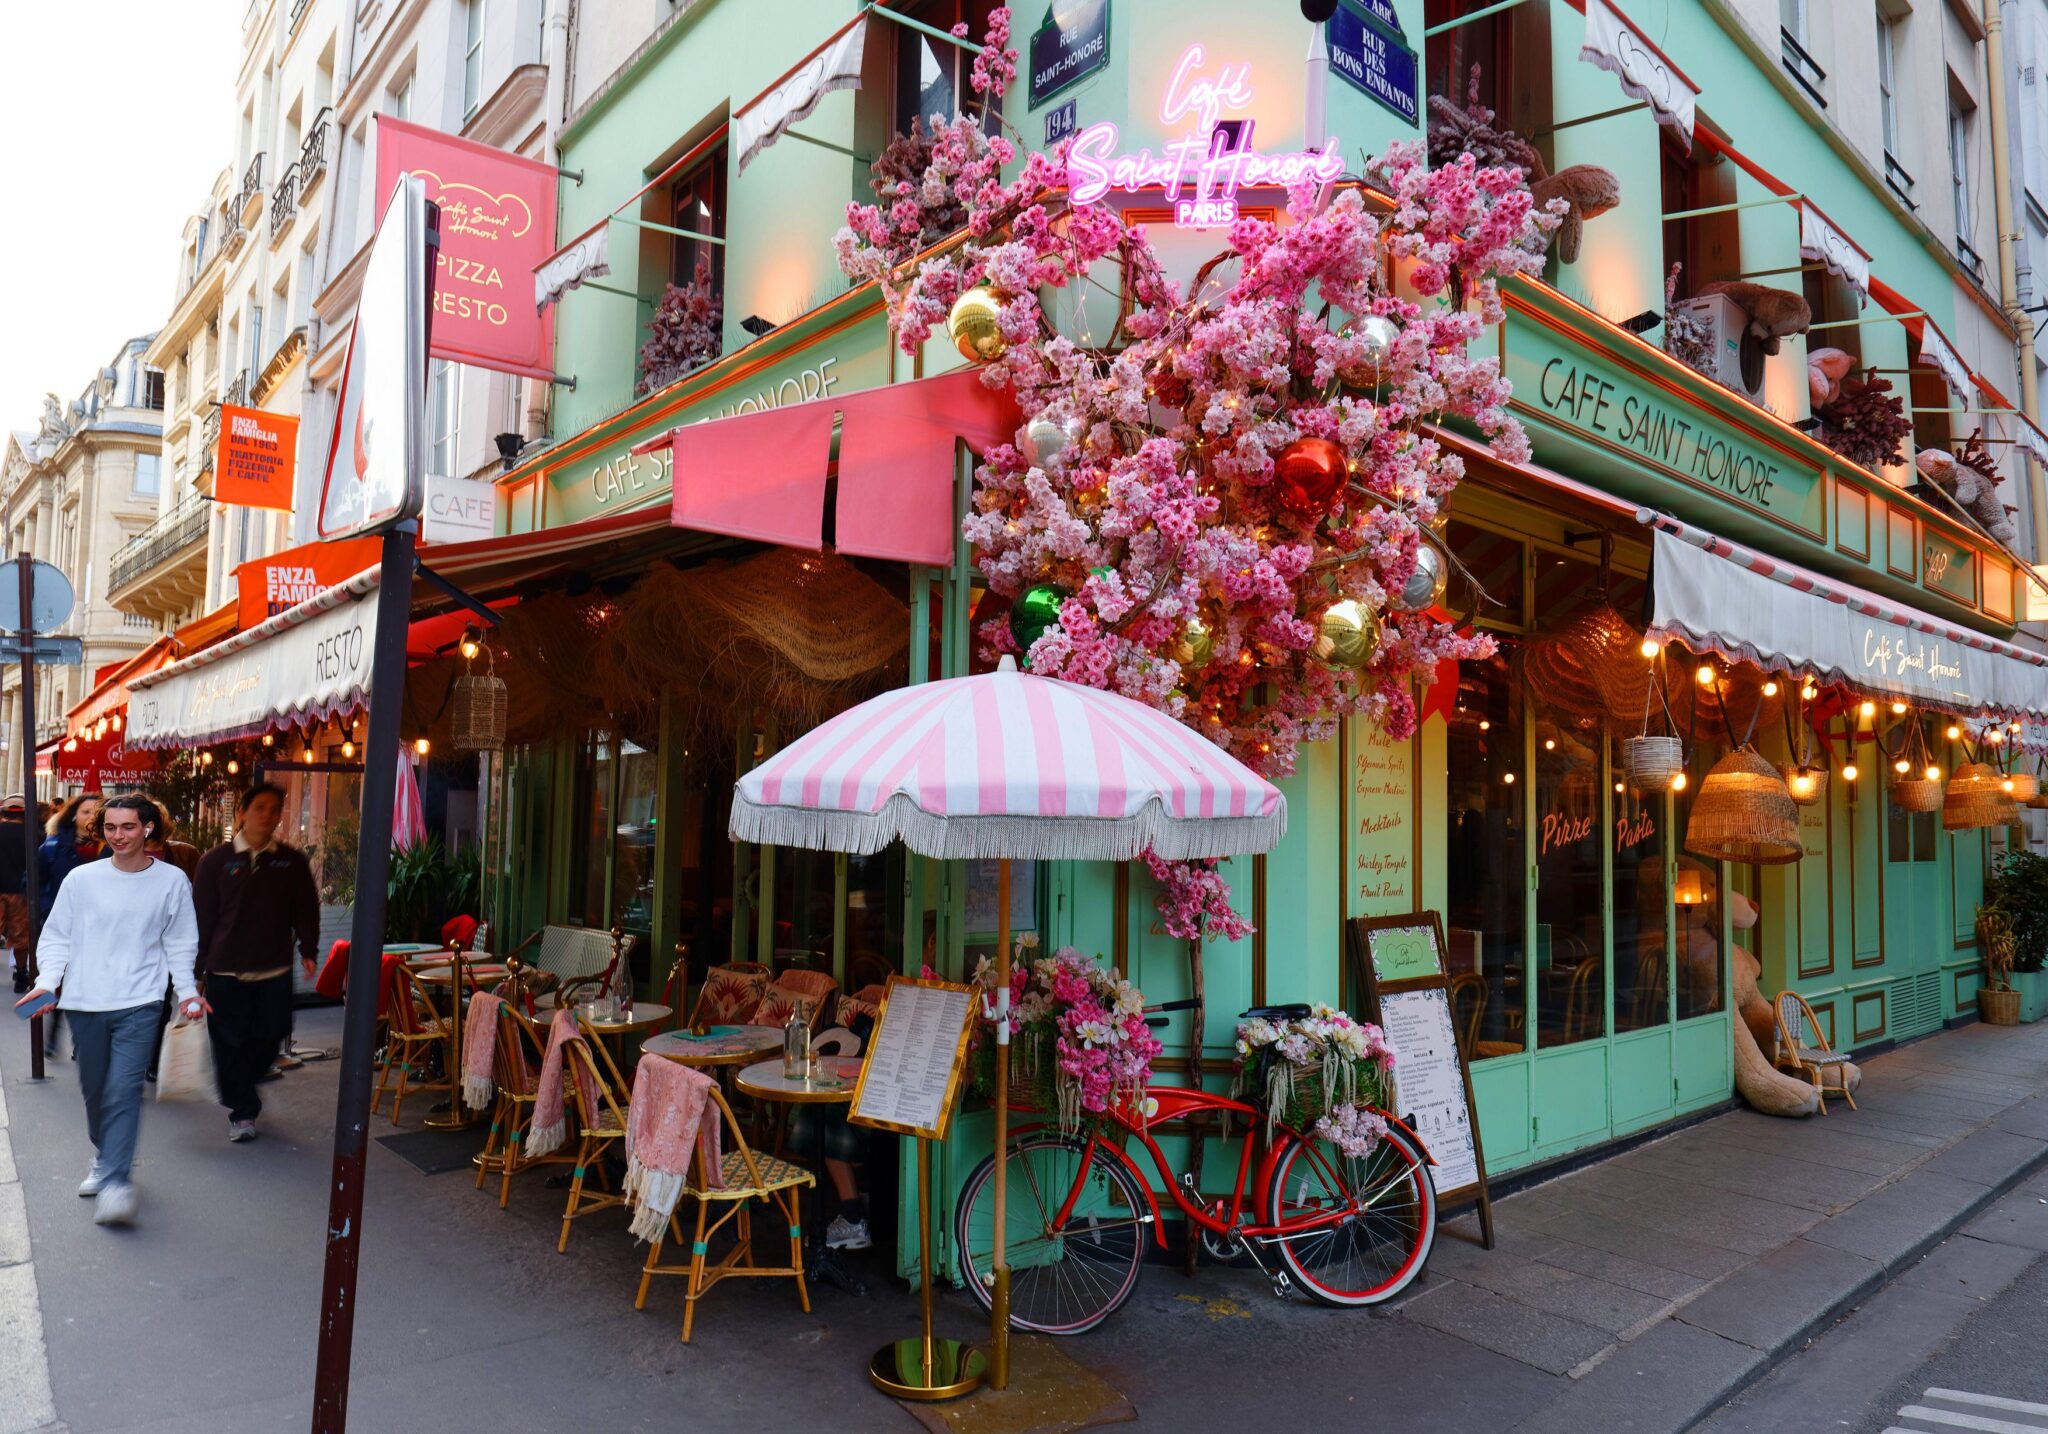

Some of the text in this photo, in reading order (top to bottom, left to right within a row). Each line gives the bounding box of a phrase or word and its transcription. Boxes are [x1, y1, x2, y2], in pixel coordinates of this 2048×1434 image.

[1059, 25, 1079, 48] RUE
[1362, 27, 1386, 58] RUE
[1035, 31, 1104, 88] SAINT-HONORÉ
[1363, 46, 1386, 76] DES
[1161, 44, 1253, 136] Café
[1332, 45, 1414, 114] BONS ENFANTS
[1046, 105, 1073, 140] 194
[1068, 119, 1346, 205] Saint Honoré
[470, 206, 510, 227] Saint
[1178, 201, 1235, 224] PARIS
[231, 425, 278, 443] FAMIGLIA
[232, 416, 258, 429] ENZA
[1540, 358, 1779, 507] CAFE SAINT HONORE
[430, 493, 492, 522] CAFE
[266, 566, 317, 585] ENZA
[315, 625, 363, 683] RESTO
[1864, 628, 1893, 676] Café
[1895, 639, 1925, 676] Saint
[1368, 732, 1391, 748] Mule
[66, 768, 90, 778] CAF
[99, 769, 138, 779] PALAIS
[1360, 811, 1402, 835] Mocktails
[1542, 808, 1656, 857] Pizze Pasta
[1358, 853, 1407, 875] Shirley Temple
[1360, 884, 1381, 899] Fruit
